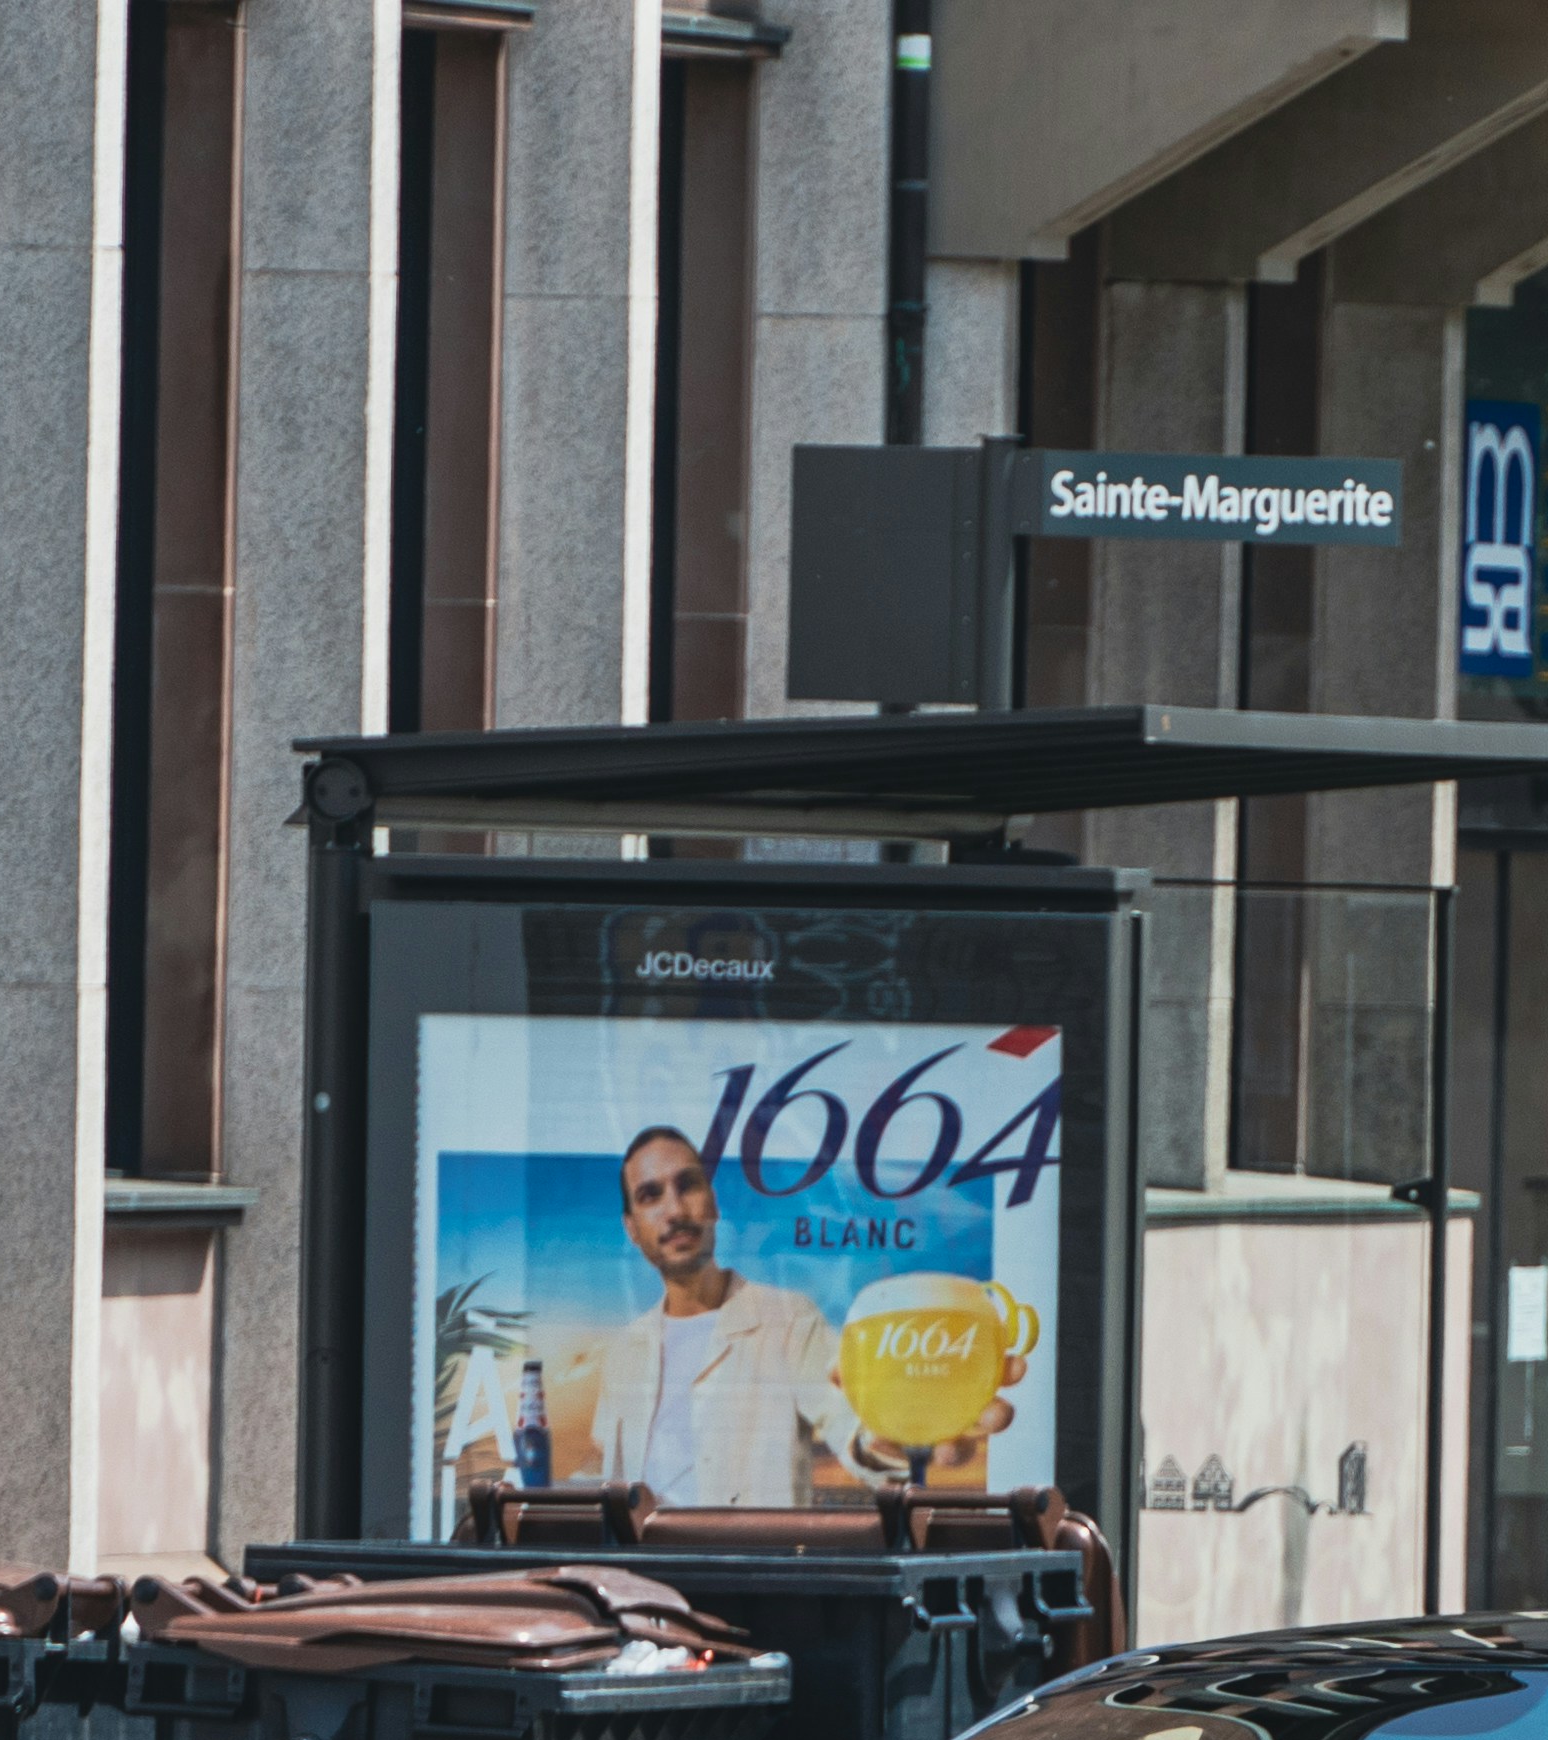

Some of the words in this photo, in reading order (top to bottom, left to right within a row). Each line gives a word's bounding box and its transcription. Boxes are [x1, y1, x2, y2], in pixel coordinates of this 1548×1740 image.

[1049, 470, 1394, 535] Sainte-Marguerite
[635, 951, 775, 982] JCDecaux
[700, 1039, 1062, 1209] 1664
[793, 1216, 917, 1250] BLANC
[875, 1315, 980, 1361] 1664
